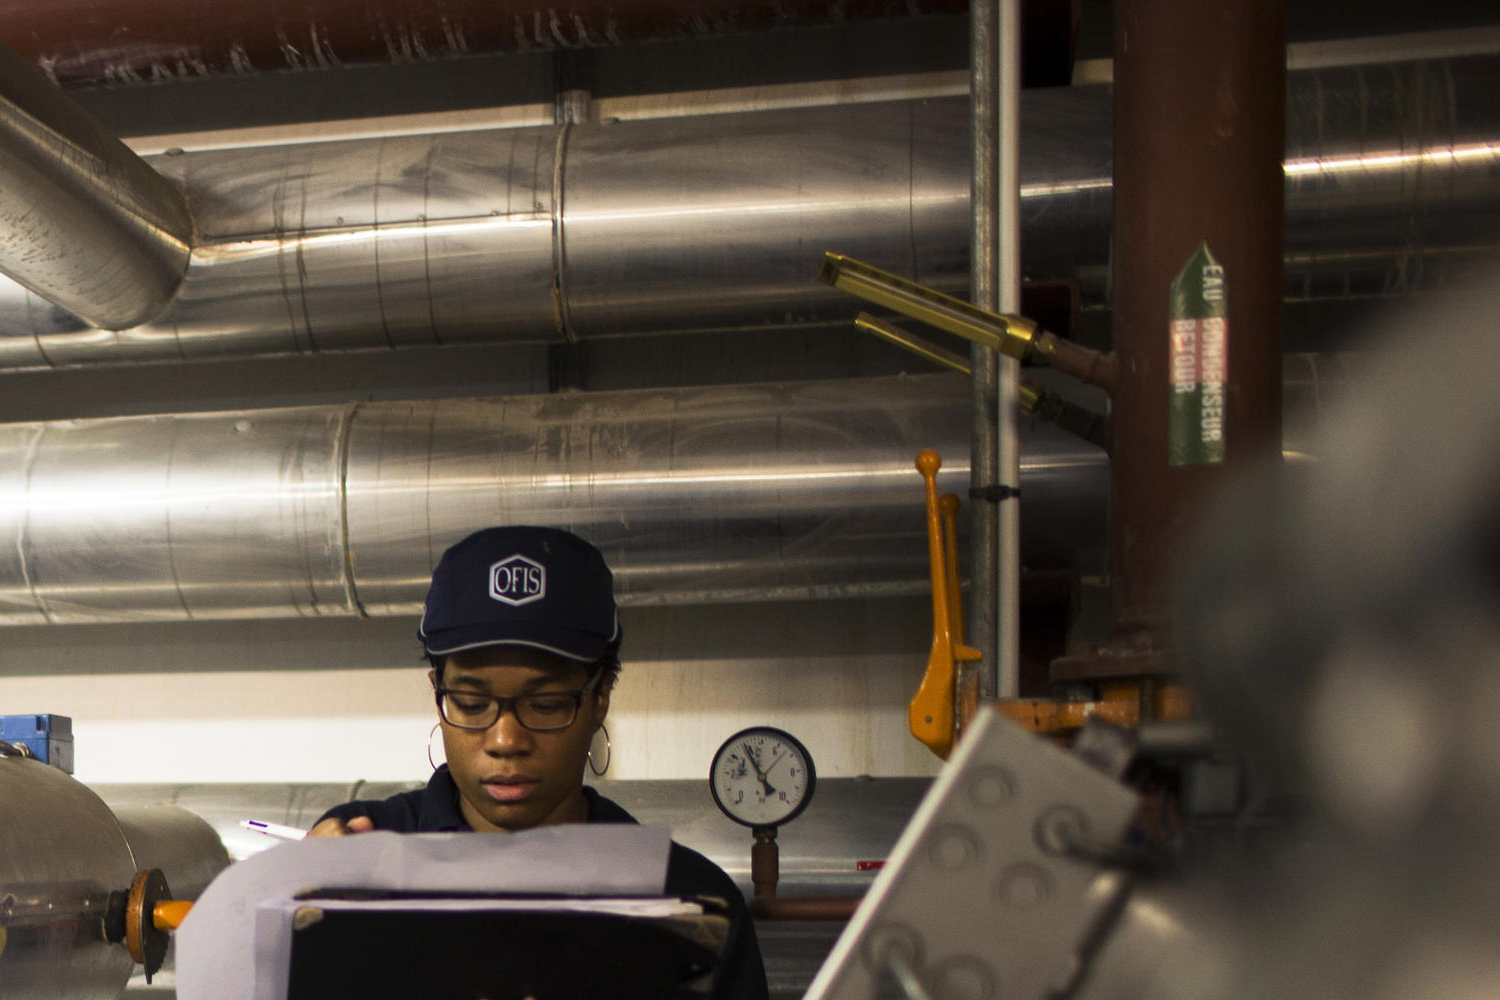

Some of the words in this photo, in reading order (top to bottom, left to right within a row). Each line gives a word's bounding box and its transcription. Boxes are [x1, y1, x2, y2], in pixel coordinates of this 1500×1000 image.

[1202, 265, 1224, 301] EAU
[1175, 318, 1197, 394] RETOUR
[1202, 317, 1224, 443] CONDENSEUR
[494, 566, 541, 594] OFIS
